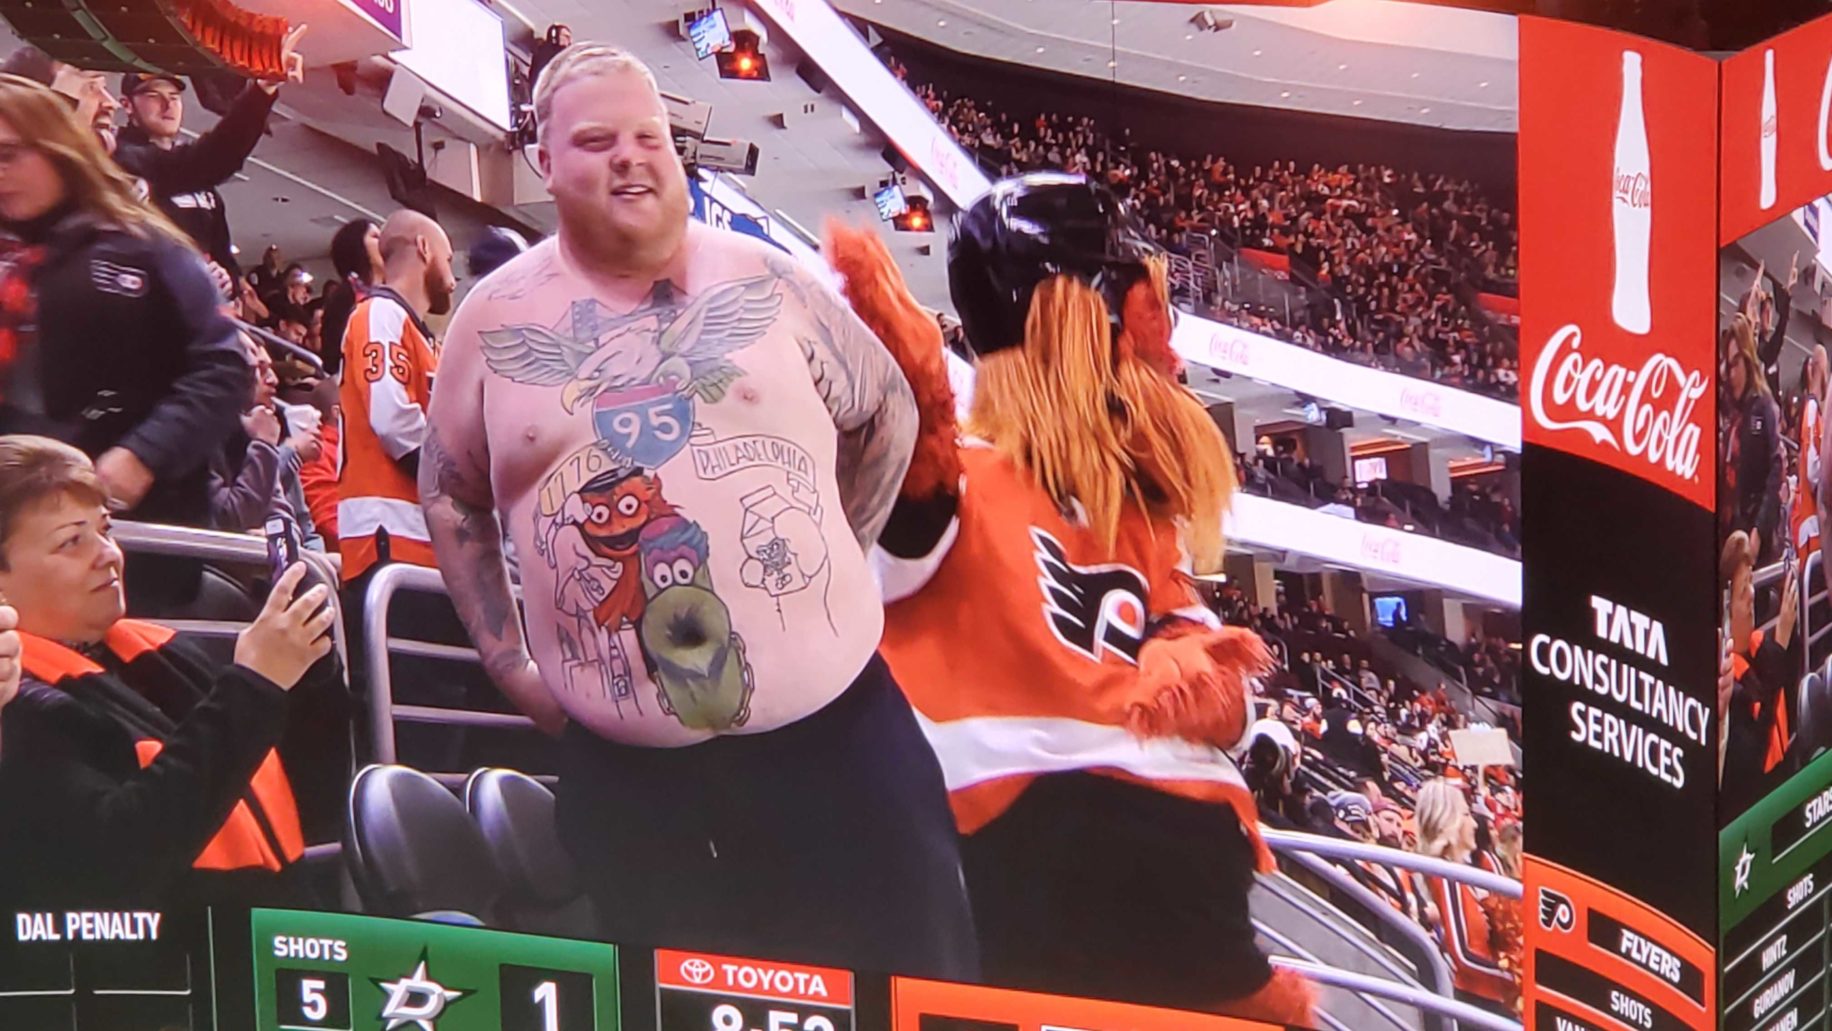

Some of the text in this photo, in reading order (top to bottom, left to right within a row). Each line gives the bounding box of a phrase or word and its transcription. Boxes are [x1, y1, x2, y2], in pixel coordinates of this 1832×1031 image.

[363, 341, 412, 385] 35
[1530, 324, 1709, 481] Coca-Cola
[612, 403, 681, 448] 95
[547, 447, 602, 512] 1776
[1590, 594, 1668, 666] TATA
[1530, 633, 1710, 746] CONSULTANCY
[1570, 701, 1685, 789] SERVICES
[1787, 873, 1813, 909] SHOTS
[17, 911, 160, 941] DAL PENALTY
[273, 935, 348, 962] SHOTS
[1620, 928, 1680, 983] FLYERS
[301, 979, 328, 1021] 5
[722, 964, 828, 997] TOYOTA
[532, 981, 562, 1031] 1
[1610, 990, 1653, 1029] SHOTS
